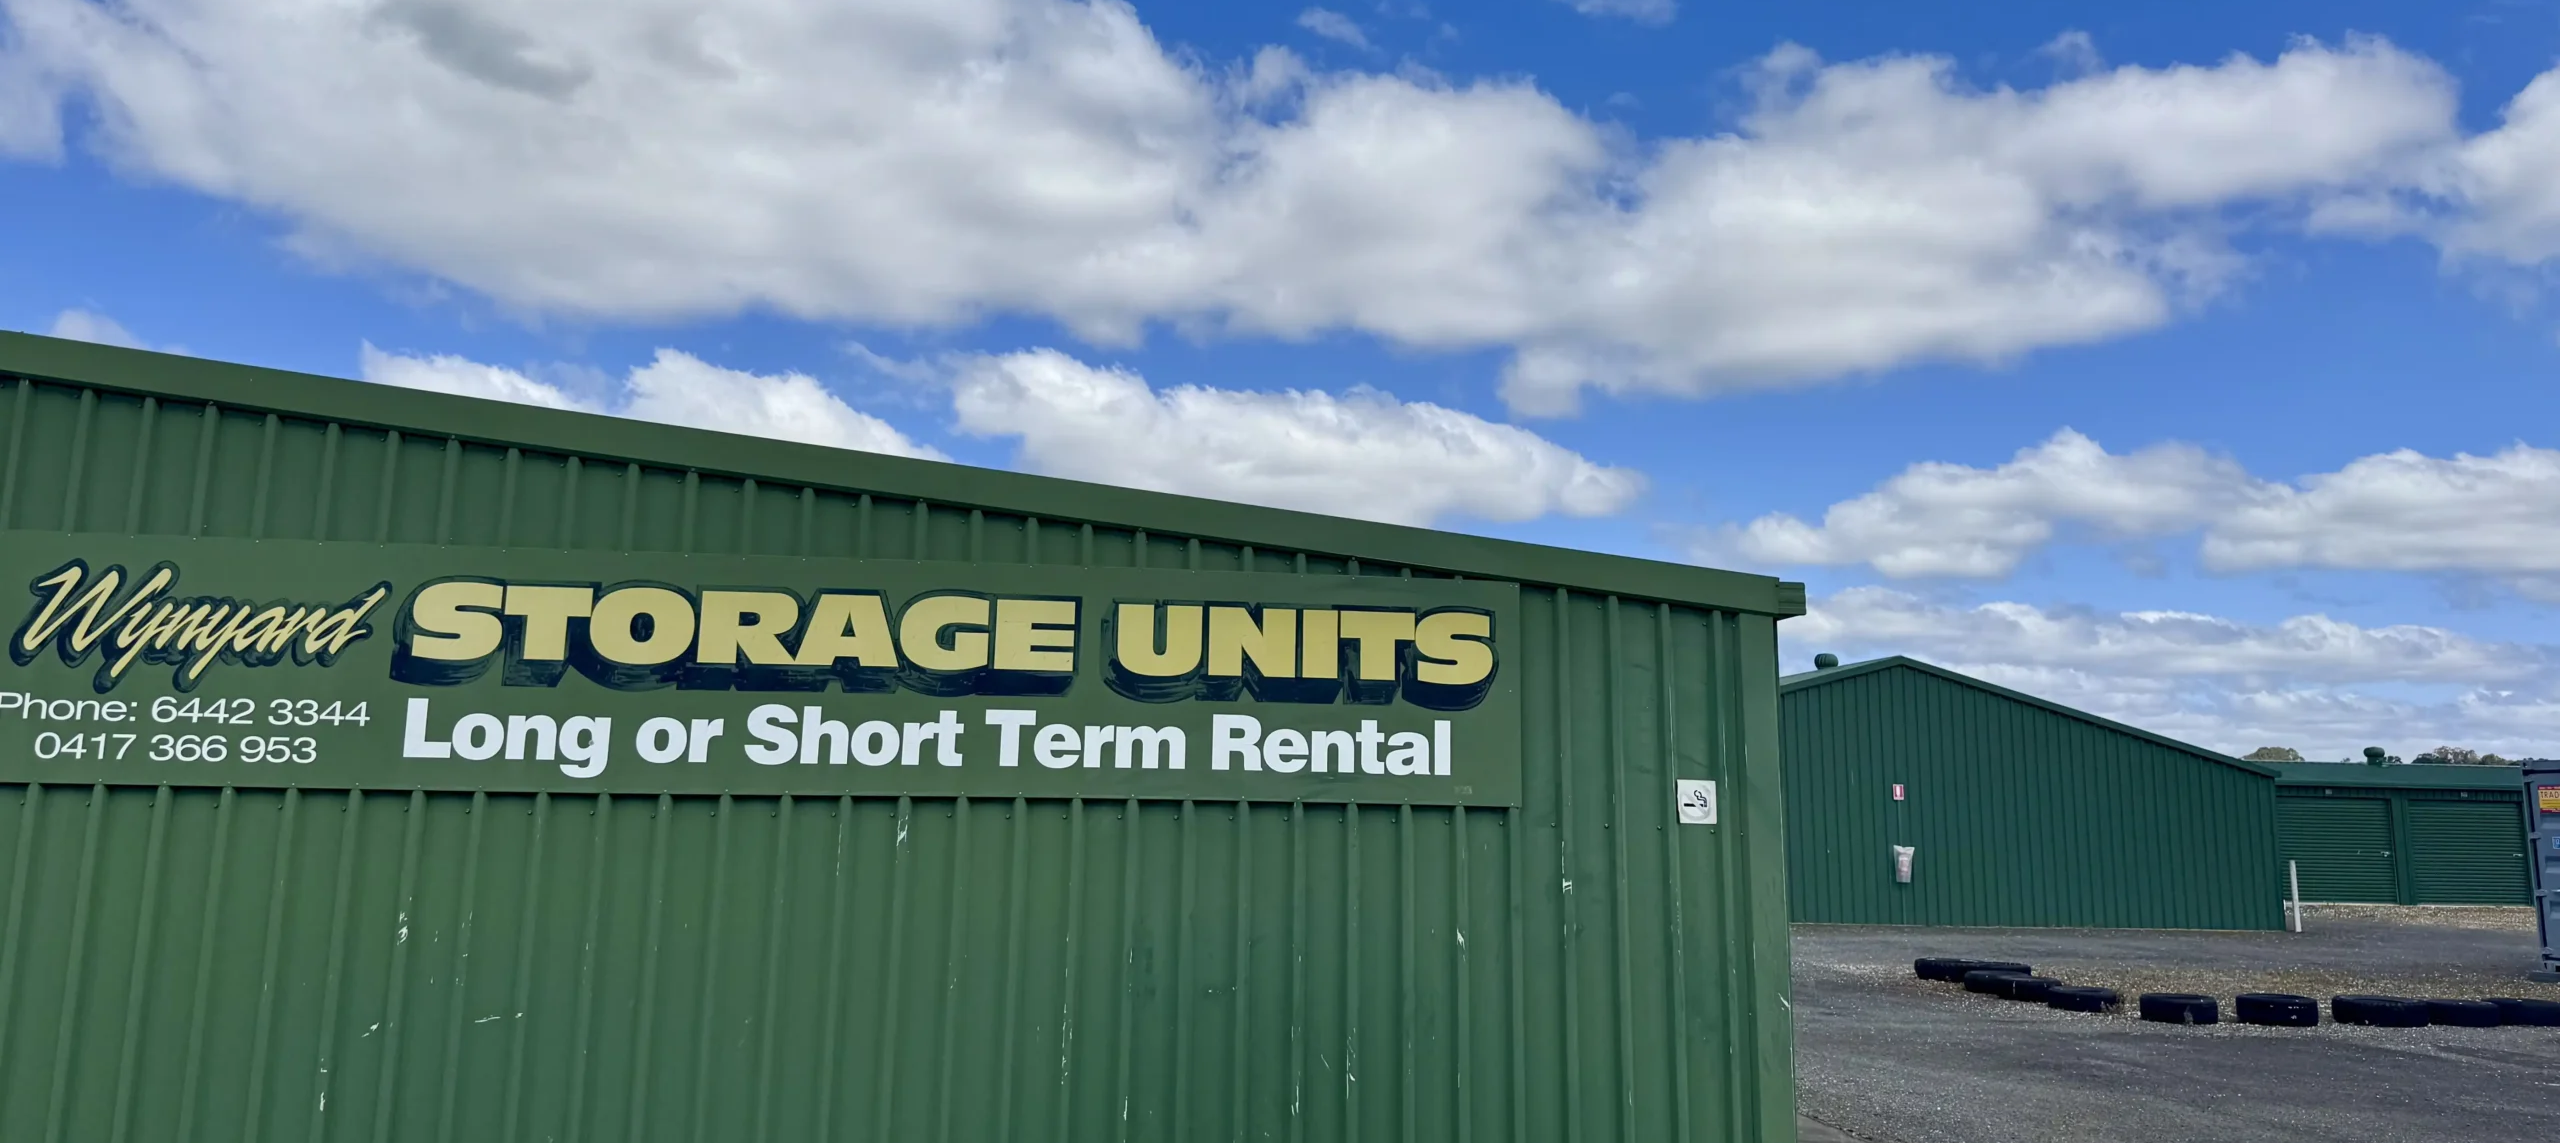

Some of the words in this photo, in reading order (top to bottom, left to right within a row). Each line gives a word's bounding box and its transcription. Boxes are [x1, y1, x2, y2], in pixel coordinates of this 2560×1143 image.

[22, 565, 388, 680] Wynyard
[407, 581, 1078, 674] STORAGE
[1115, 602, 1495, 689] UNITS
[0, 691, 138, 722] Phone:
[150, 695, 256, 726] 6442
[267, 697, 371, 727] 3344
[402, 696, 612, 779] Long
[635, 715, 726, 765] or
[743, 702, 966, 768] Short
[984, 708, 1187, 771] Term
[1210, 712, 1453, 777] Rental
[34, 731, 137, 760] 0417
[148, 733, 228, 763] 366
[239, 735, 318, 764] 953
